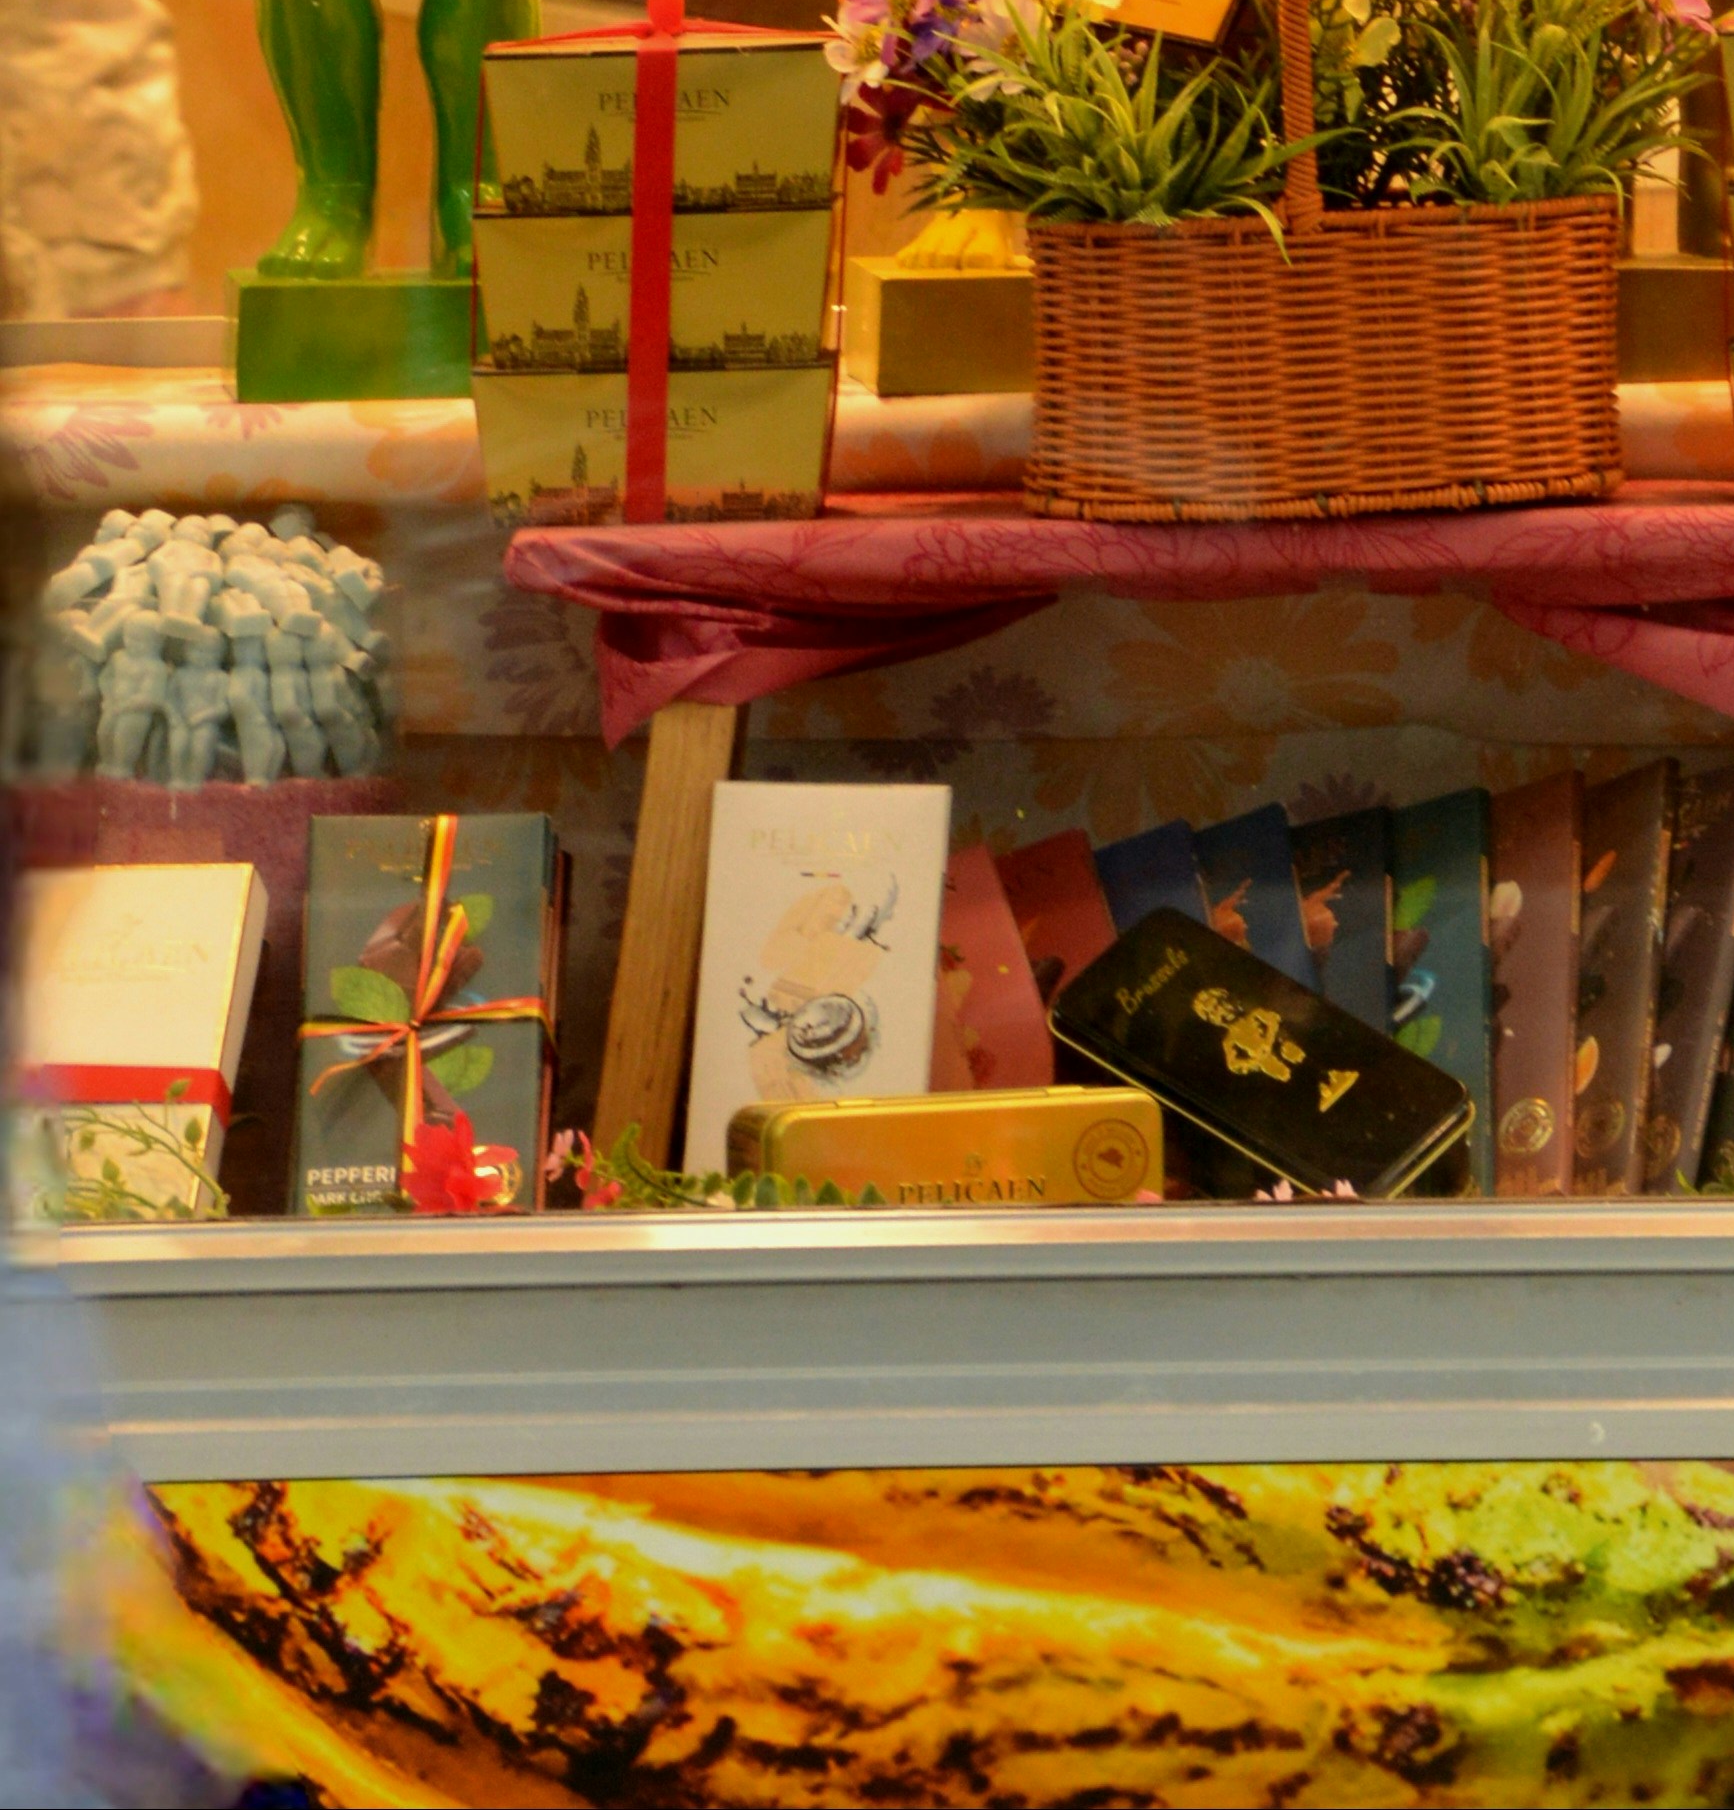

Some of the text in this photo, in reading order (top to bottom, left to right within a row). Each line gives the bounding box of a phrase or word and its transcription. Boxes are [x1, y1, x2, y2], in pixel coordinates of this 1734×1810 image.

[587, 248, 719, 272] PELAEN
[585, 406, 718, 429] PELAEN
[899, 1174, 1046, 1205] PELICAEN
